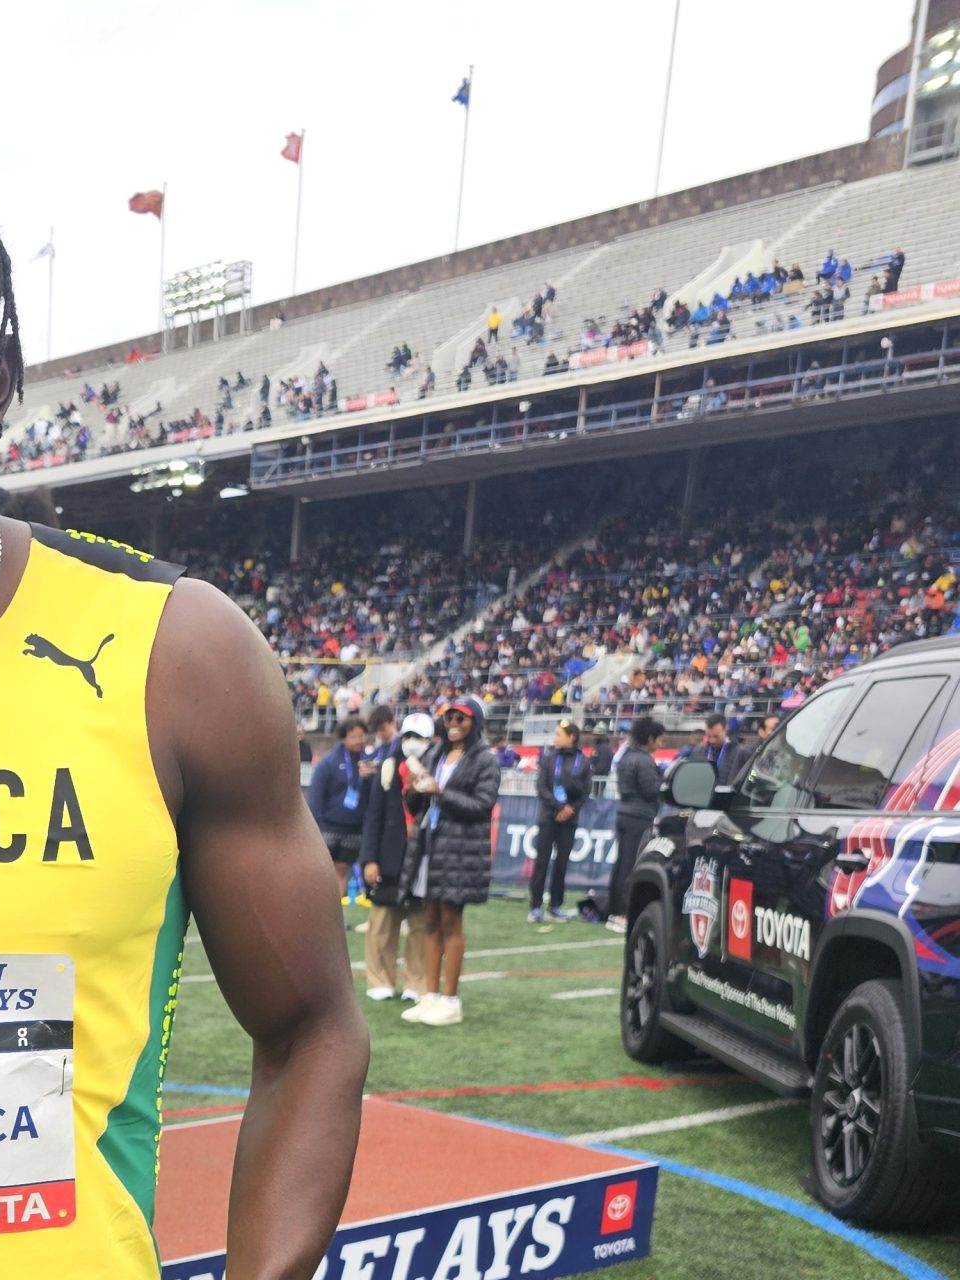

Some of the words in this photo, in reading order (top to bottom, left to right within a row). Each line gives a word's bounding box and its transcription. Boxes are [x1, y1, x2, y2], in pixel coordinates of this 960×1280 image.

[506, 823, 619, 864] TOOT
[754, 905, 811, 961] TOYOTA
[592, 1237, 636, 1260] TOYOTA
